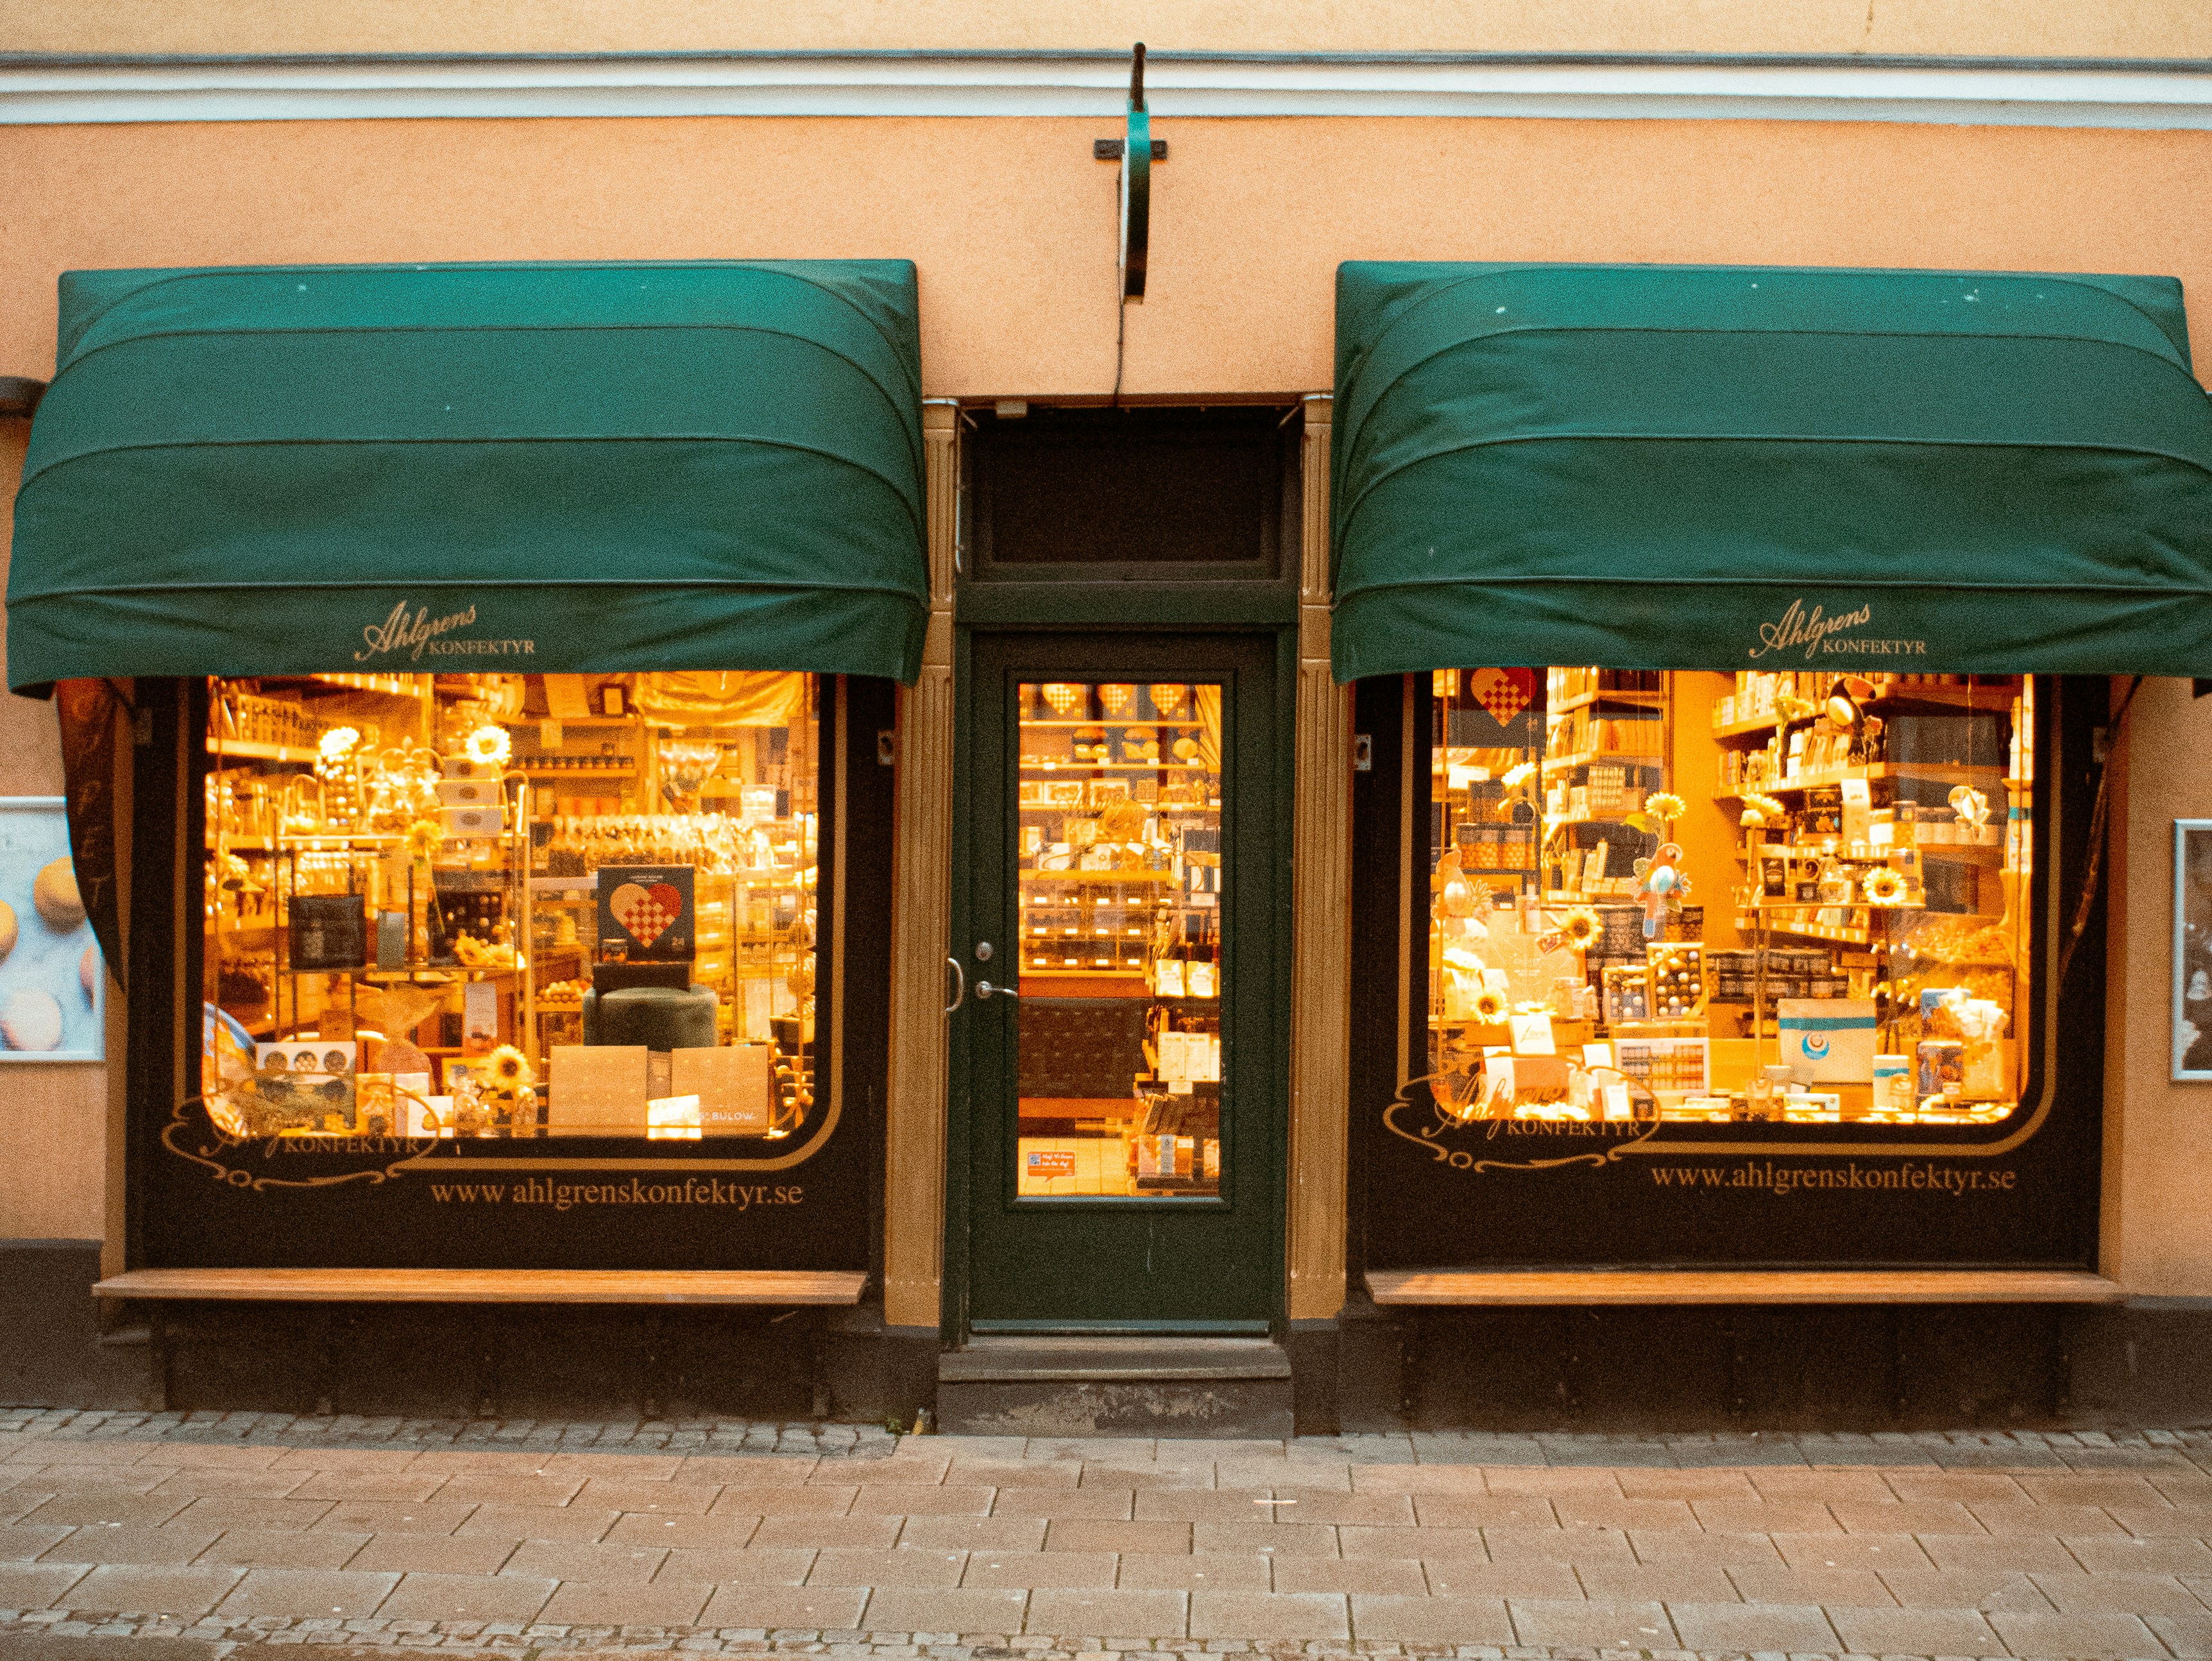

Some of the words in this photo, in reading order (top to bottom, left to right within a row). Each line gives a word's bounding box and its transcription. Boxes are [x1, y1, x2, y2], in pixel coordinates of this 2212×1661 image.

[353, 600, 476, 662] Ahlgrens
[1749, 598, 1870, 659] Ahlgrens
[429, 640, 535, 654] KONFEKTYR
[1823, 640, 1927, 654] KONFEKTYR
[1507, 1121, 1640, 1136] KONFEKTYR
[284, 1137, 419, 1153] KONFEKTYR
[1652, 1161, 2015, 1195] www.ahlgrenskonfektyr.se
[513, 1177, 804, 1211] ahlgrenskonfektyr.se
